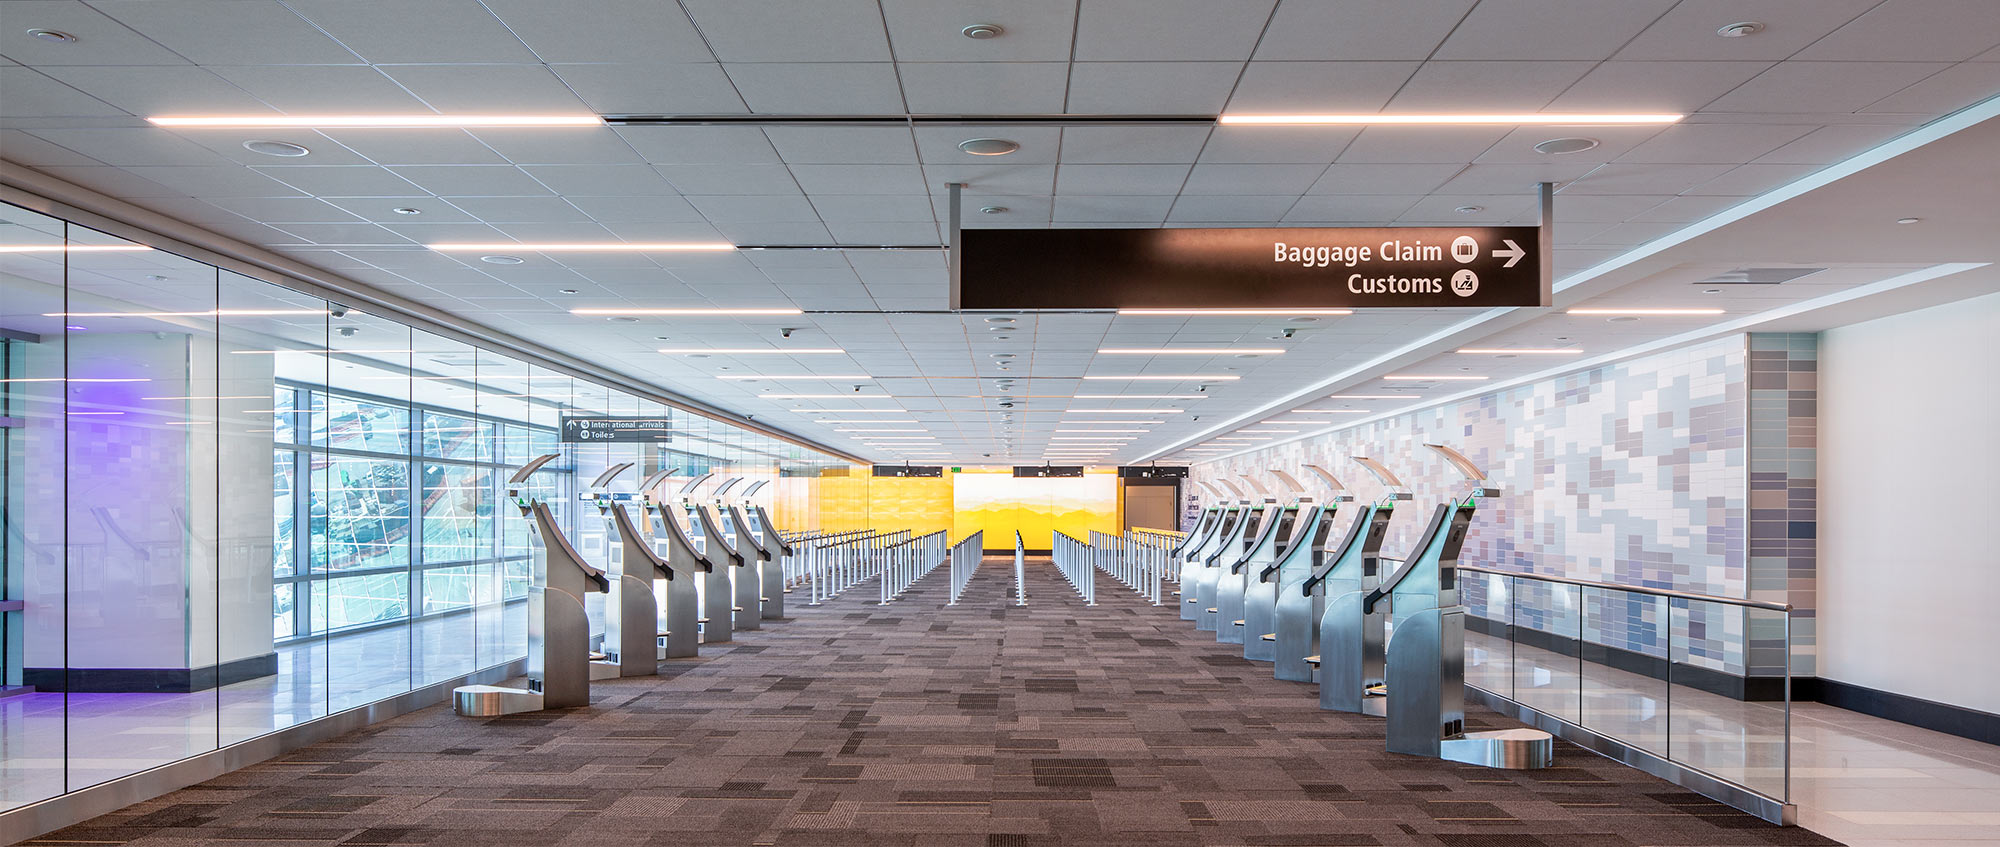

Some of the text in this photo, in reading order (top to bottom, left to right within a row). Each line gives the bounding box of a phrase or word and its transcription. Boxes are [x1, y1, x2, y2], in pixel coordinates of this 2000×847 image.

[1273, 240, 1443, 268] Baggage Claim
[1347, 273, 1443, 294] Customs
[591, 431, 615, 439] Toiles
